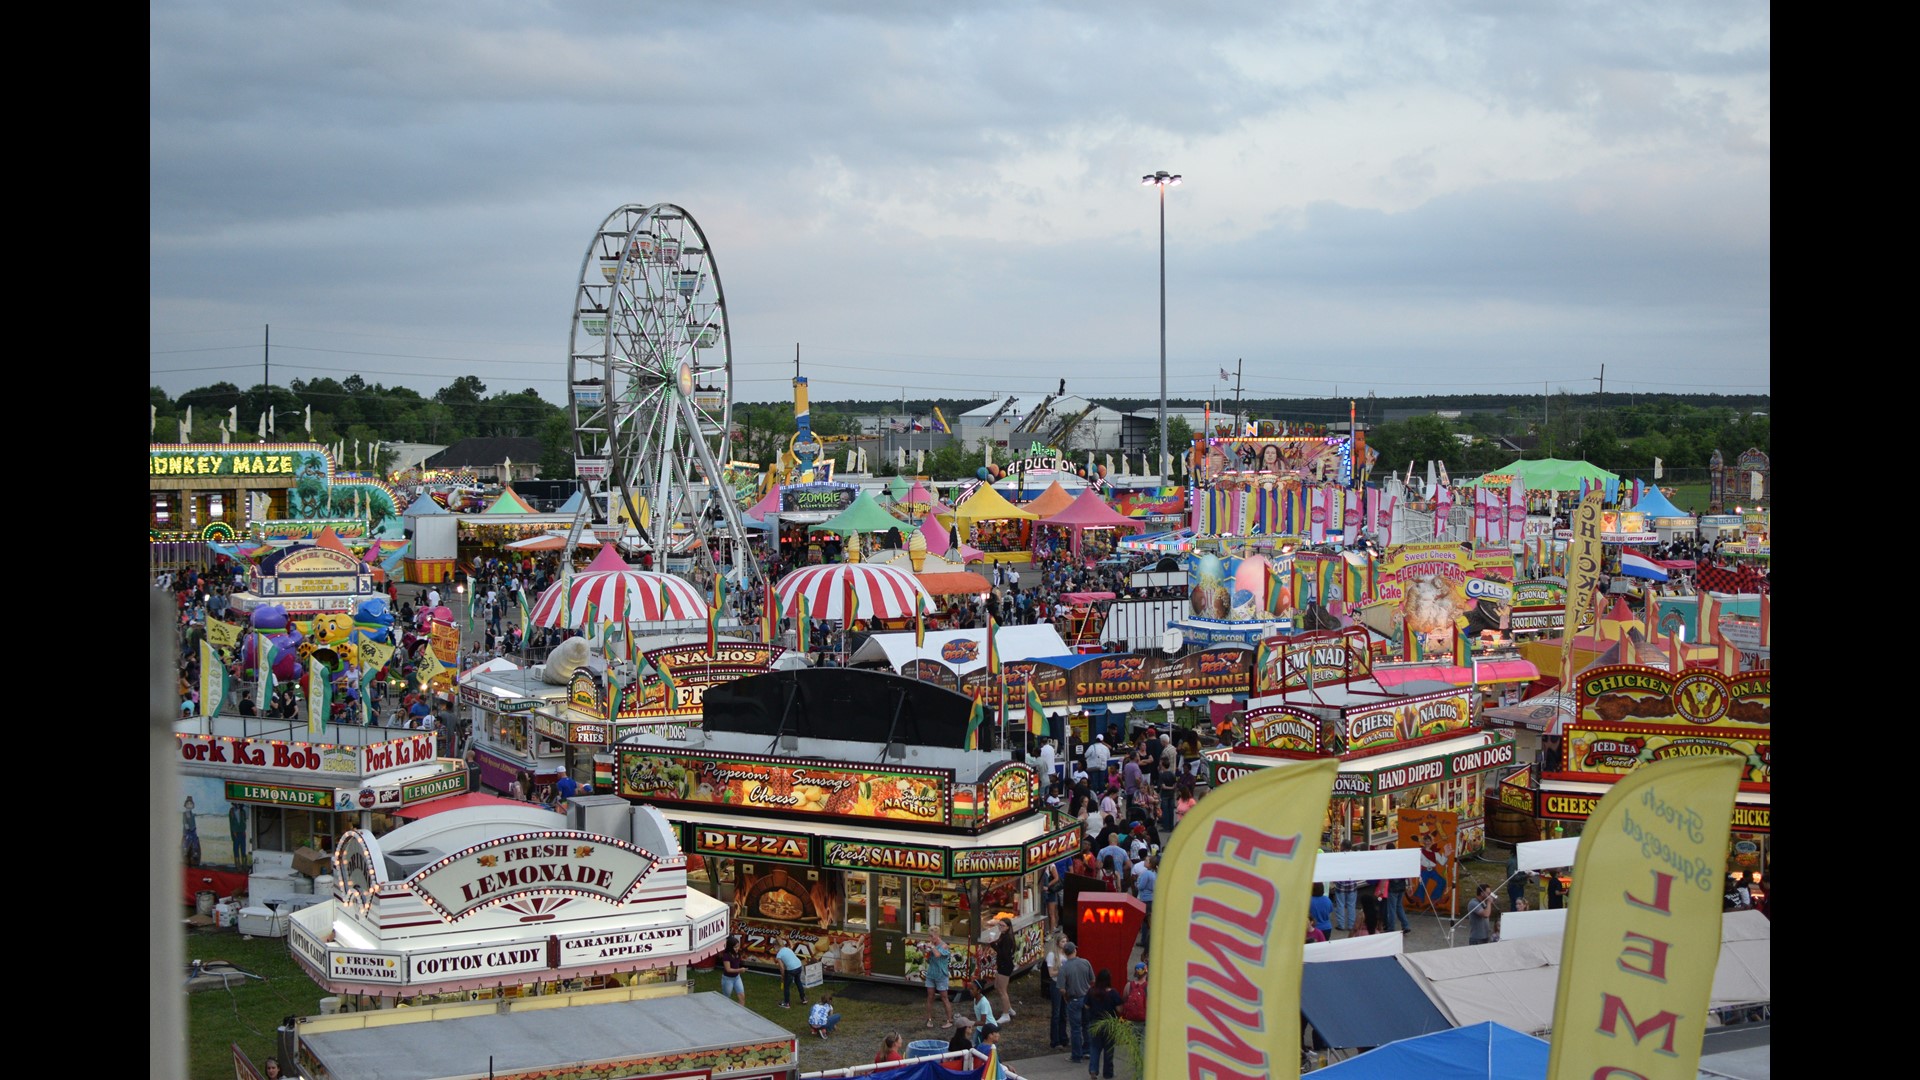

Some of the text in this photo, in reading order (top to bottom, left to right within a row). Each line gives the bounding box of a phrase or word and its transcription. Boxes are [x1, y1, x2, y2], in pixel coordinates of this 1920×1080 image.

[1214, 420, 1327, 437] WINDSURF
[1030, 441, 1057, 457] Alien
[233, 456, 292, 473] MAZE
[1007, 456, 1077, 476] ADUCTON
[799, 492, 841, 503] ZOMBIE
[1673, 519, 1695, 527] TICKETS
[1719, 517, 1741, 525] TICKETS
[265, 523, 366, 540] RISING WTERS
[283, 551, 353, 572] FUNNEL CAKES
[1404, 550, 1457, 562] Sweet Cheeks
[1395, 562, 1466, 585] ELEPHANT EARS
[284, 583, 350, 593] LEMONADE
[1379, 584, 1402, 600] Cake
[1468, 580, 1512, 598] OREO
[1517, 591, 1549, 601] LEMONADE
[1511, 616, 1548, 629] FOOT LONG
[943, 643, 956, 651] BIG
[944, 651, 967, 660] BEEF
[1101, 660, 1116, 669] BIG
[1200, 653, 1215, 662] BIG
[1101, 669, 1128, 680] BEEF
[1201, 662, 1226, 673] BEEF
[688, 674, 741, 683] CHIL CHEESE
[1037, 677, 1067, 693] TIP
[1076, 681, 1151, 696] SIRLOIN
[1155, 678, 1185, 690] TIP
[1586, 674, 1672, 697] CHICKEN
[1676, 676, 1698, 696] CHICKEN
[1713, 679, 1728, 698] STICK
[1076, 696, 1104, 704] SAUTEED
[1104, 693, 1144, 702] MUSHROOMS
[1146, 691, 1170, 699] ONIONS
[1185, 688, 1213, 696] POTATOES
[1216, 686, 1233, 694] STEAK
[1234, 685, 1250, 693] SAND
[1731, 681, 1763, 698] ON A
[576, 724, 605, 733] CHEESE
[1352, 703, 1457, 740] CHEESE NACHOS
[577, 732, 604, 743] FRIES
[654, 724, 687, 739] HOT DOGS
[1264, 721, 1313, 744] LEMONADE
[1363, 730, 1395, 746] ON-A-STICK
[1593, 742, 1637, 754] ICED TEA
[1695, 739, 1728, 747] SQUEEZED
[231, 740, 267, 766] Ka
[272, 743, 321, 770] Bob
[366, 737, 433, 773] Pork Ka Bob
[1660, 745, 1735, 760] LEMONA
[1378, 744, 1512, 790] HAND DIPPED CORN DOGS
[1605, 757, 1635, 769] Sweet
[703, 761, 852, 793] Pepperoni Sausage
[1217, 766, 1258, 783] COR
[408, 777, 462, 799] LEMONADE
[630, 780, 675, 792] SALADS
[1332, 779, 1372, 793] ONADE
[244, 786, 315, 804] LEMONADE
[749, 785, 798, 805] Cheese
[900, 790, 937, 806] Supreme
[1002, 791, 1028, 801] NACHOS
[1501, 792, 1533, 811] LEMONADE
[883, 798, 937, 817] NACHOS
[1547, 796, 1601, 815] CHEES
[703, 831, 803, 857] PIZZA
[1029, 831, 1079, 864] PIZZA
[504, 845, 569, 863] FRESH
[829, 842, 942, 871] Fresh SALADS
[984, 850, 1019, 859] Squeezed
[956, 856, 1019, 873] LEMONADE
[460, 863, 614, 903] LEMONADE
[1082, 908, 1124, 924] ATM
[698, 917, 725, 941] DRINKS
[739, 922, 819, 941] Pepperoni Cheese
[565, 928, 684, 950] CARAMEL/CANDY
[292, 928, 327, 968] COTTON CANDY
[599, 943, 653, 958] APPLES
[346, 955, 385, 967] FRESH
[416, 948, 541, 976] COTTON CANDY
[335, 965, 398, 979] LEMONADE
